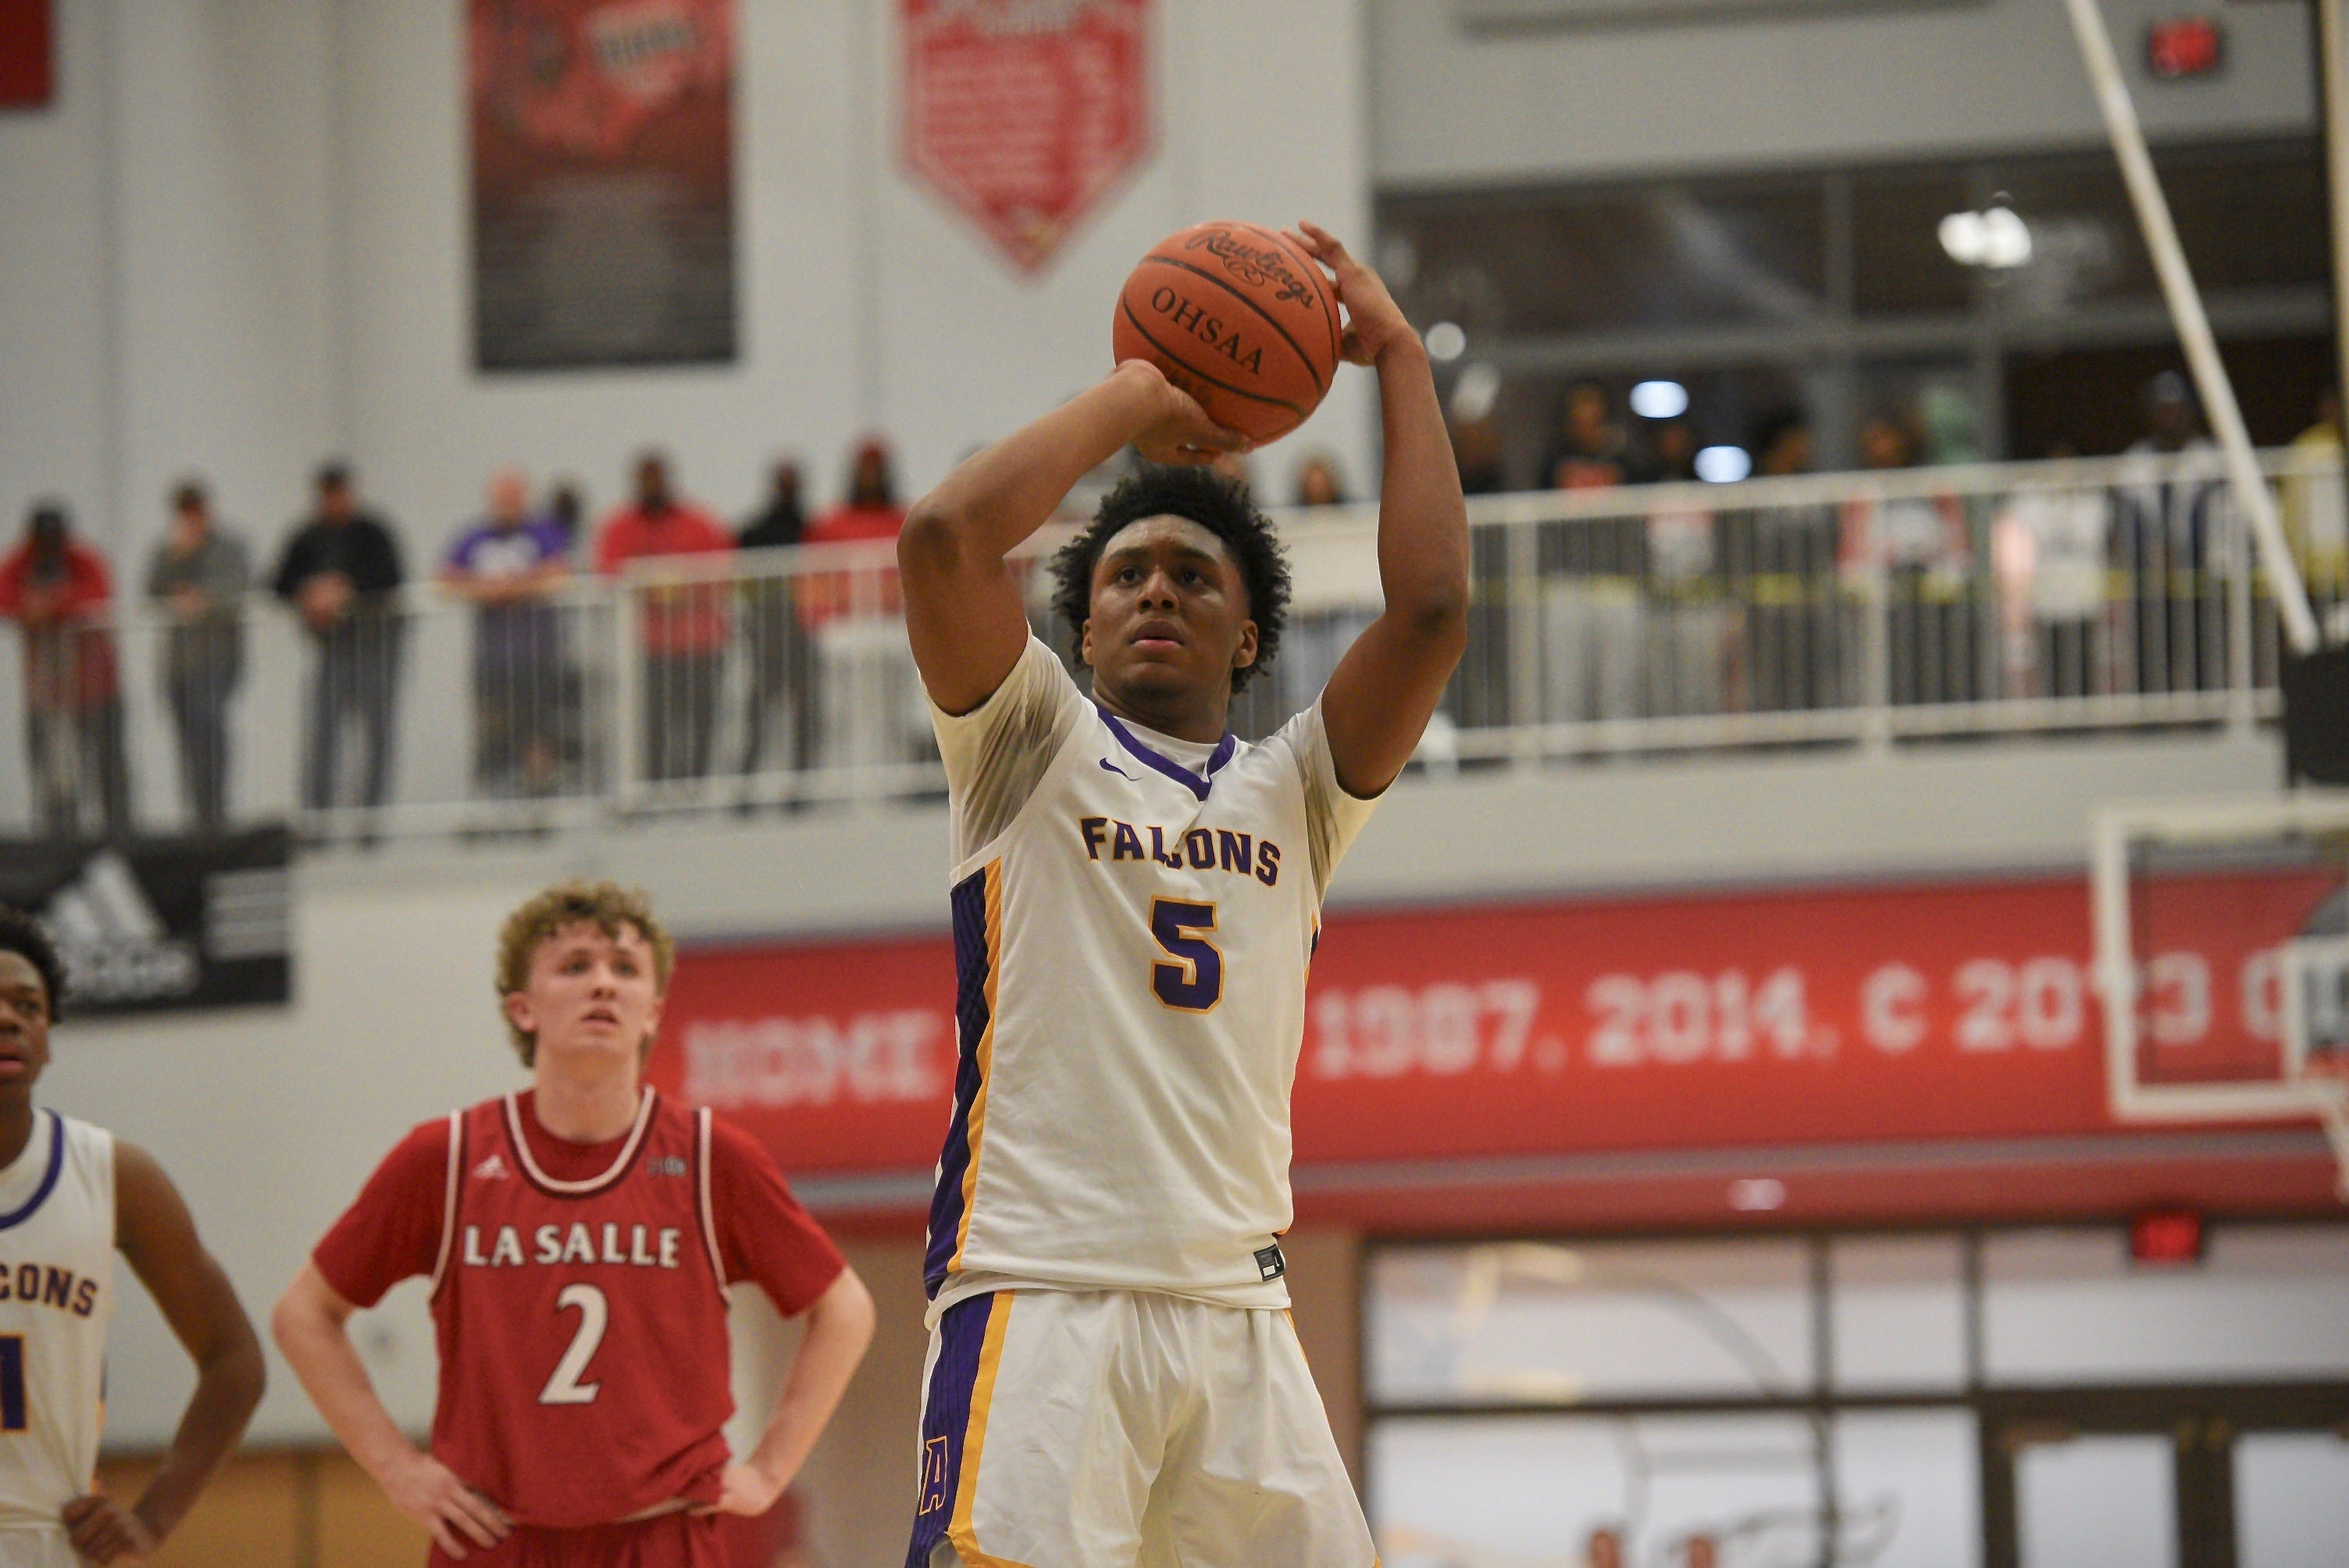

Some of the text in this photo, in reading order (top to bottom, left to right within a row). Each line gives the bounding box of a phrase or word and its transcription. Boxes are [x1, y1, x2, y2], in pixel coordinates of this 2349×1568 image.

[1185, 230, 1314, 309] Rawlings
[1152, 286, 1264, 375] OHSAA
[1149, 896, 1225, 1014] 5
[1955, 951, 2211, 1051] 203
[463, 1222, 681, 1269] LA SALLE
[538, 1283, 608, 1405] 2
[919, 1435, 947, 1516] A
